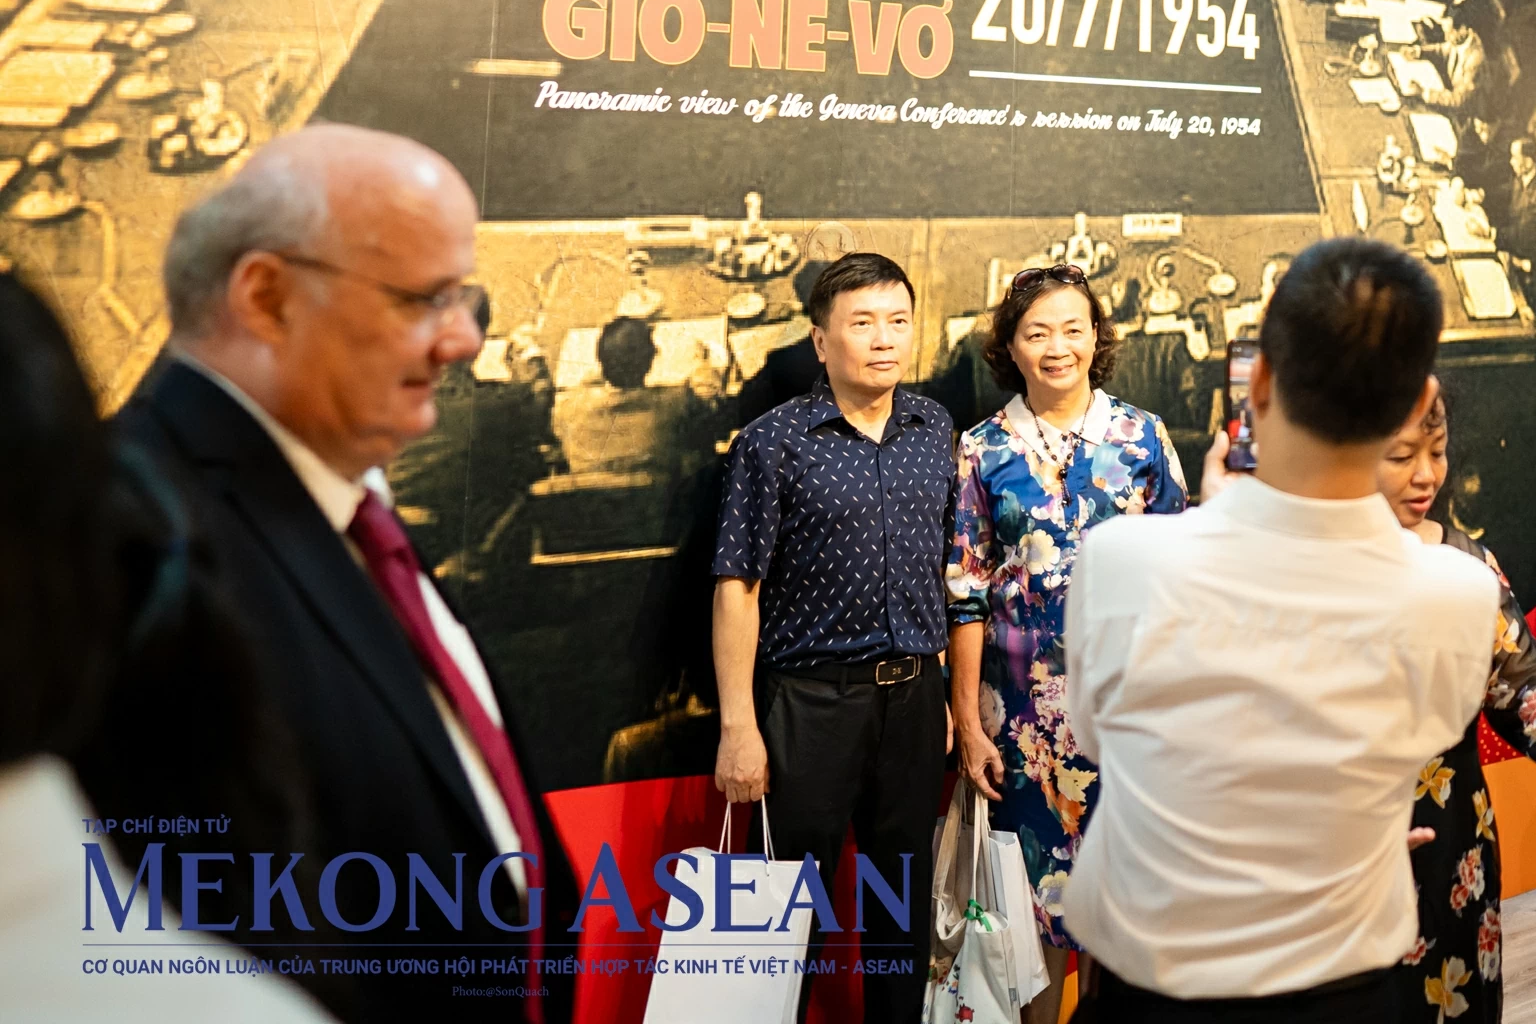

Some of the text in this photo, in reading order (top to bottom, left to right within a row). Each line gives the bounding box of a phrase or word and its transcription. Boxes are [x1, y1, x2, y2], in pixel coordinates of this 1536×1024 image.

[534, 80, 673, 113] Panoramic
[678, 89, 739, 115] view
[744, 93, 778, 123] of
[778, 92, 814, 118] the
[818, 93, 898, 122] Geneva
[1031, 107, 1113, 131] session
[1117, 115, 1142, 131] on
[1144, 109, 1184, 139] July
[1187, 115, 1216, 136] 20,
[1220, 117, 1262, 136] 1954
